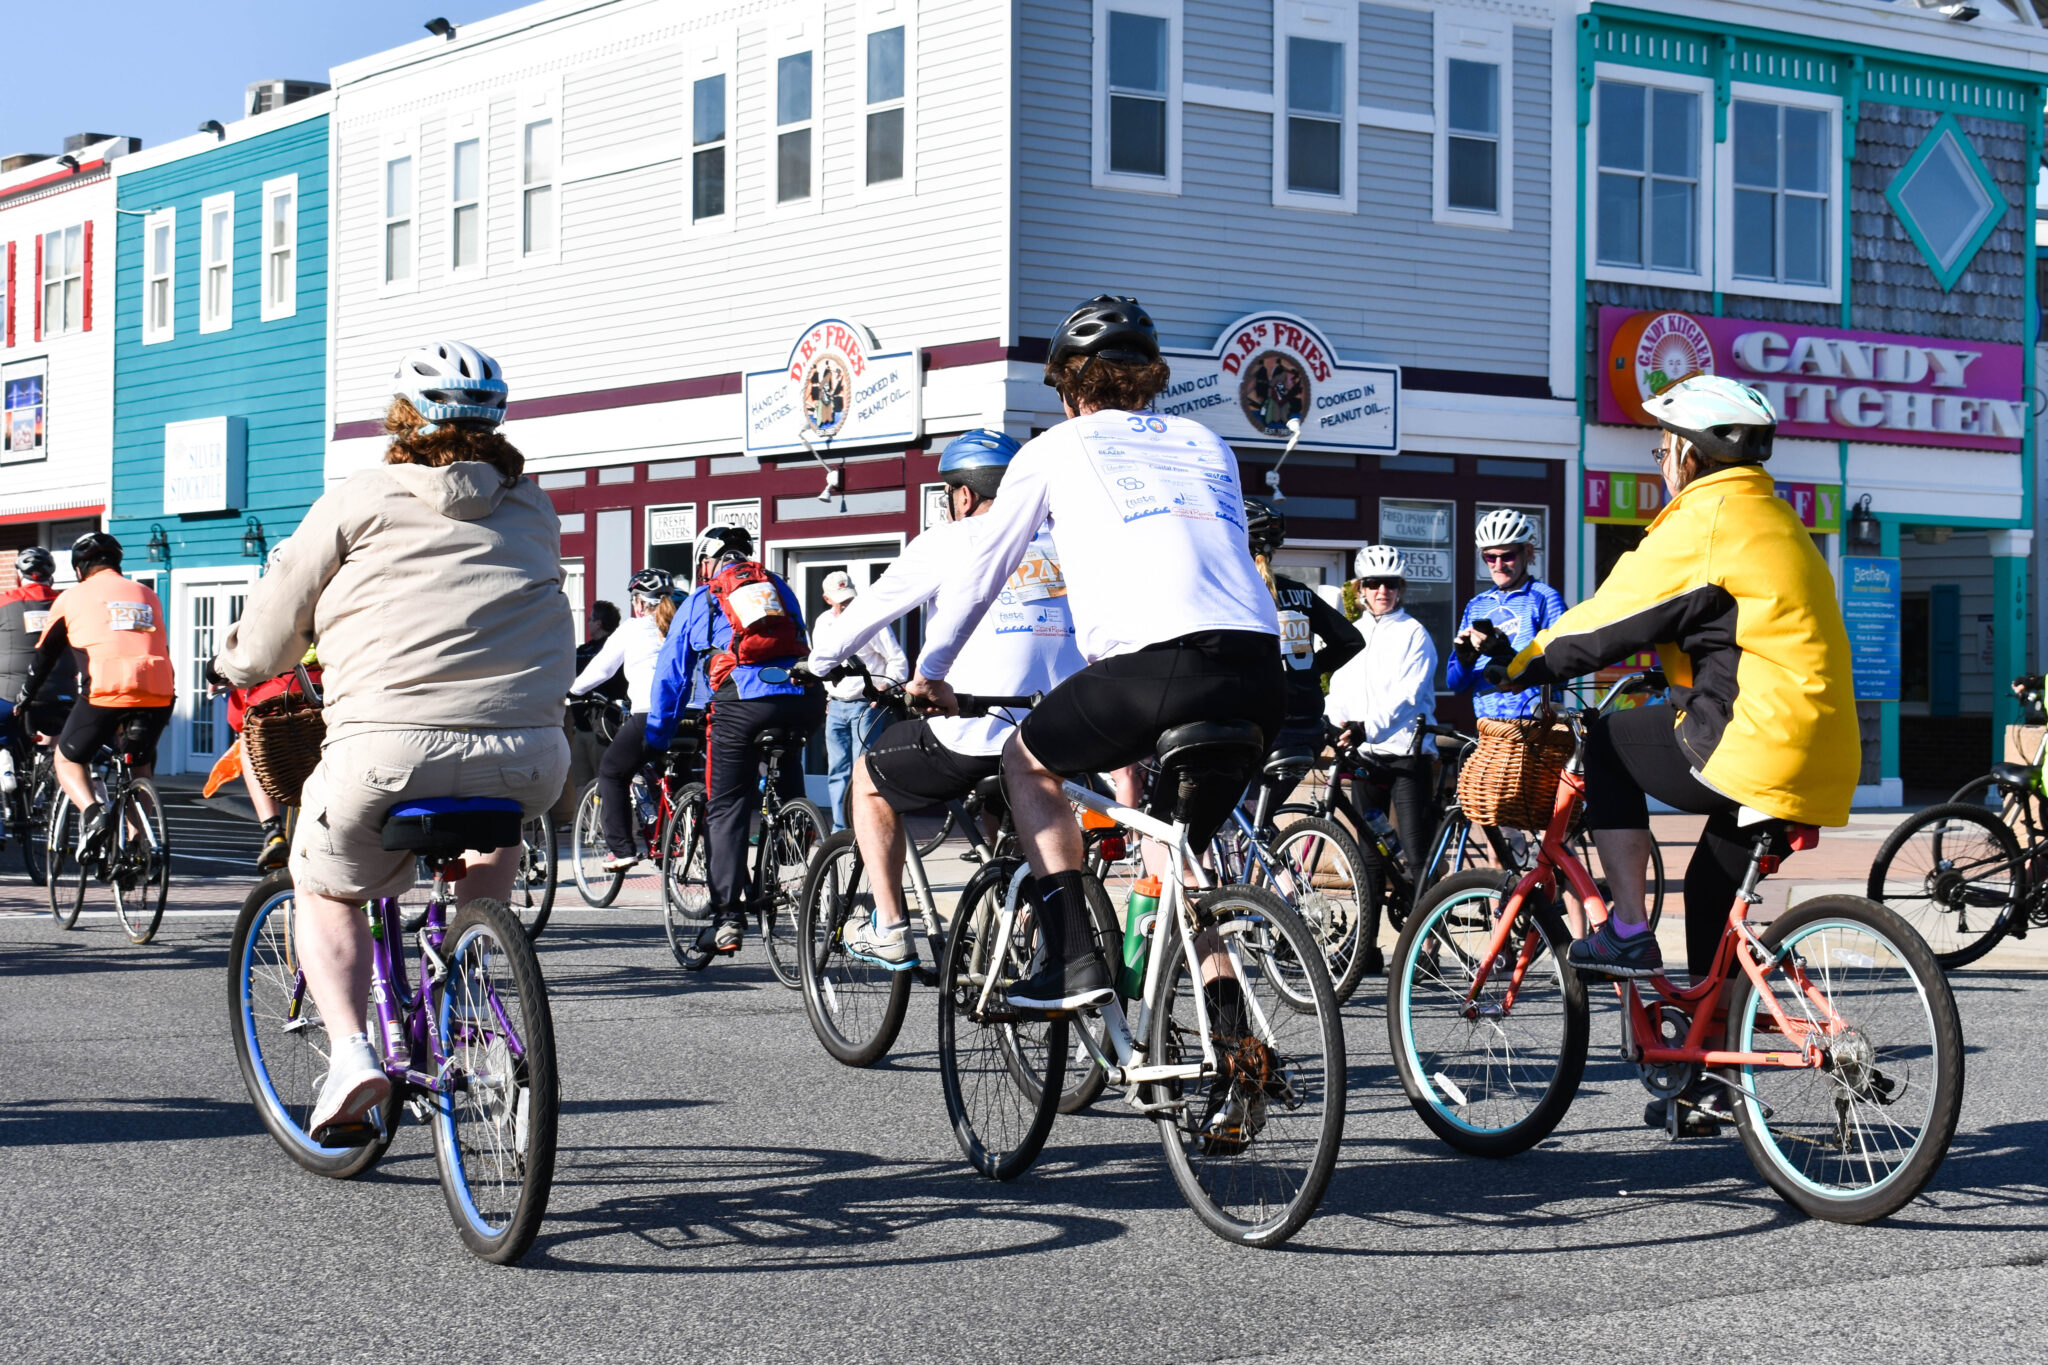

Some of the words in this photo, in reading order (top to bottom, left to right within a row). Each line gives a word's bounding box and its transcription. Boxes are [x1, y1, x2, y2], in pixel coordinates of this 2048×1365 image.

[825, 325, 867, 377] FRIES
[1273, 322, 1331, 382] FRIES
[1638, 317, 1666, 366] CANDY
[1668, 315, 1711, 368] KITCHEN
[1731, 331, 1982, 388] CANDY
[854, 376, 890, 403] COOKED
[890, 369, 899, 384] IN
[1197, 374, 1219, 390] CUT
[752, 395, 773, 415] HAND
[773, 384, 788, 402] CUT
[857, 396, 889, 423] PEANUT
[1317, 388, 1362, 410] COOKED
[1363, 384, 1375, 396] IN
[1752, 378, 2029, 438] ITCHEN
[1320, 408, 1362, 428] PEANUT
[189, 442, 222, 470] SILVER
[168, 472, 223, 502] STOCKPILE
[658, 515, 687, 528] FRESH
[1383, 510, 1403, 523] FRIED
[1404, 512, 1445, 526] IPSWICH
[1395, 524, 1426, 536] CLAMS
[654, 526, 691, 540] OYSTERS
[1404, 552, 1436, 565] RESH
[1407, 564, 1443, 578] STERS
